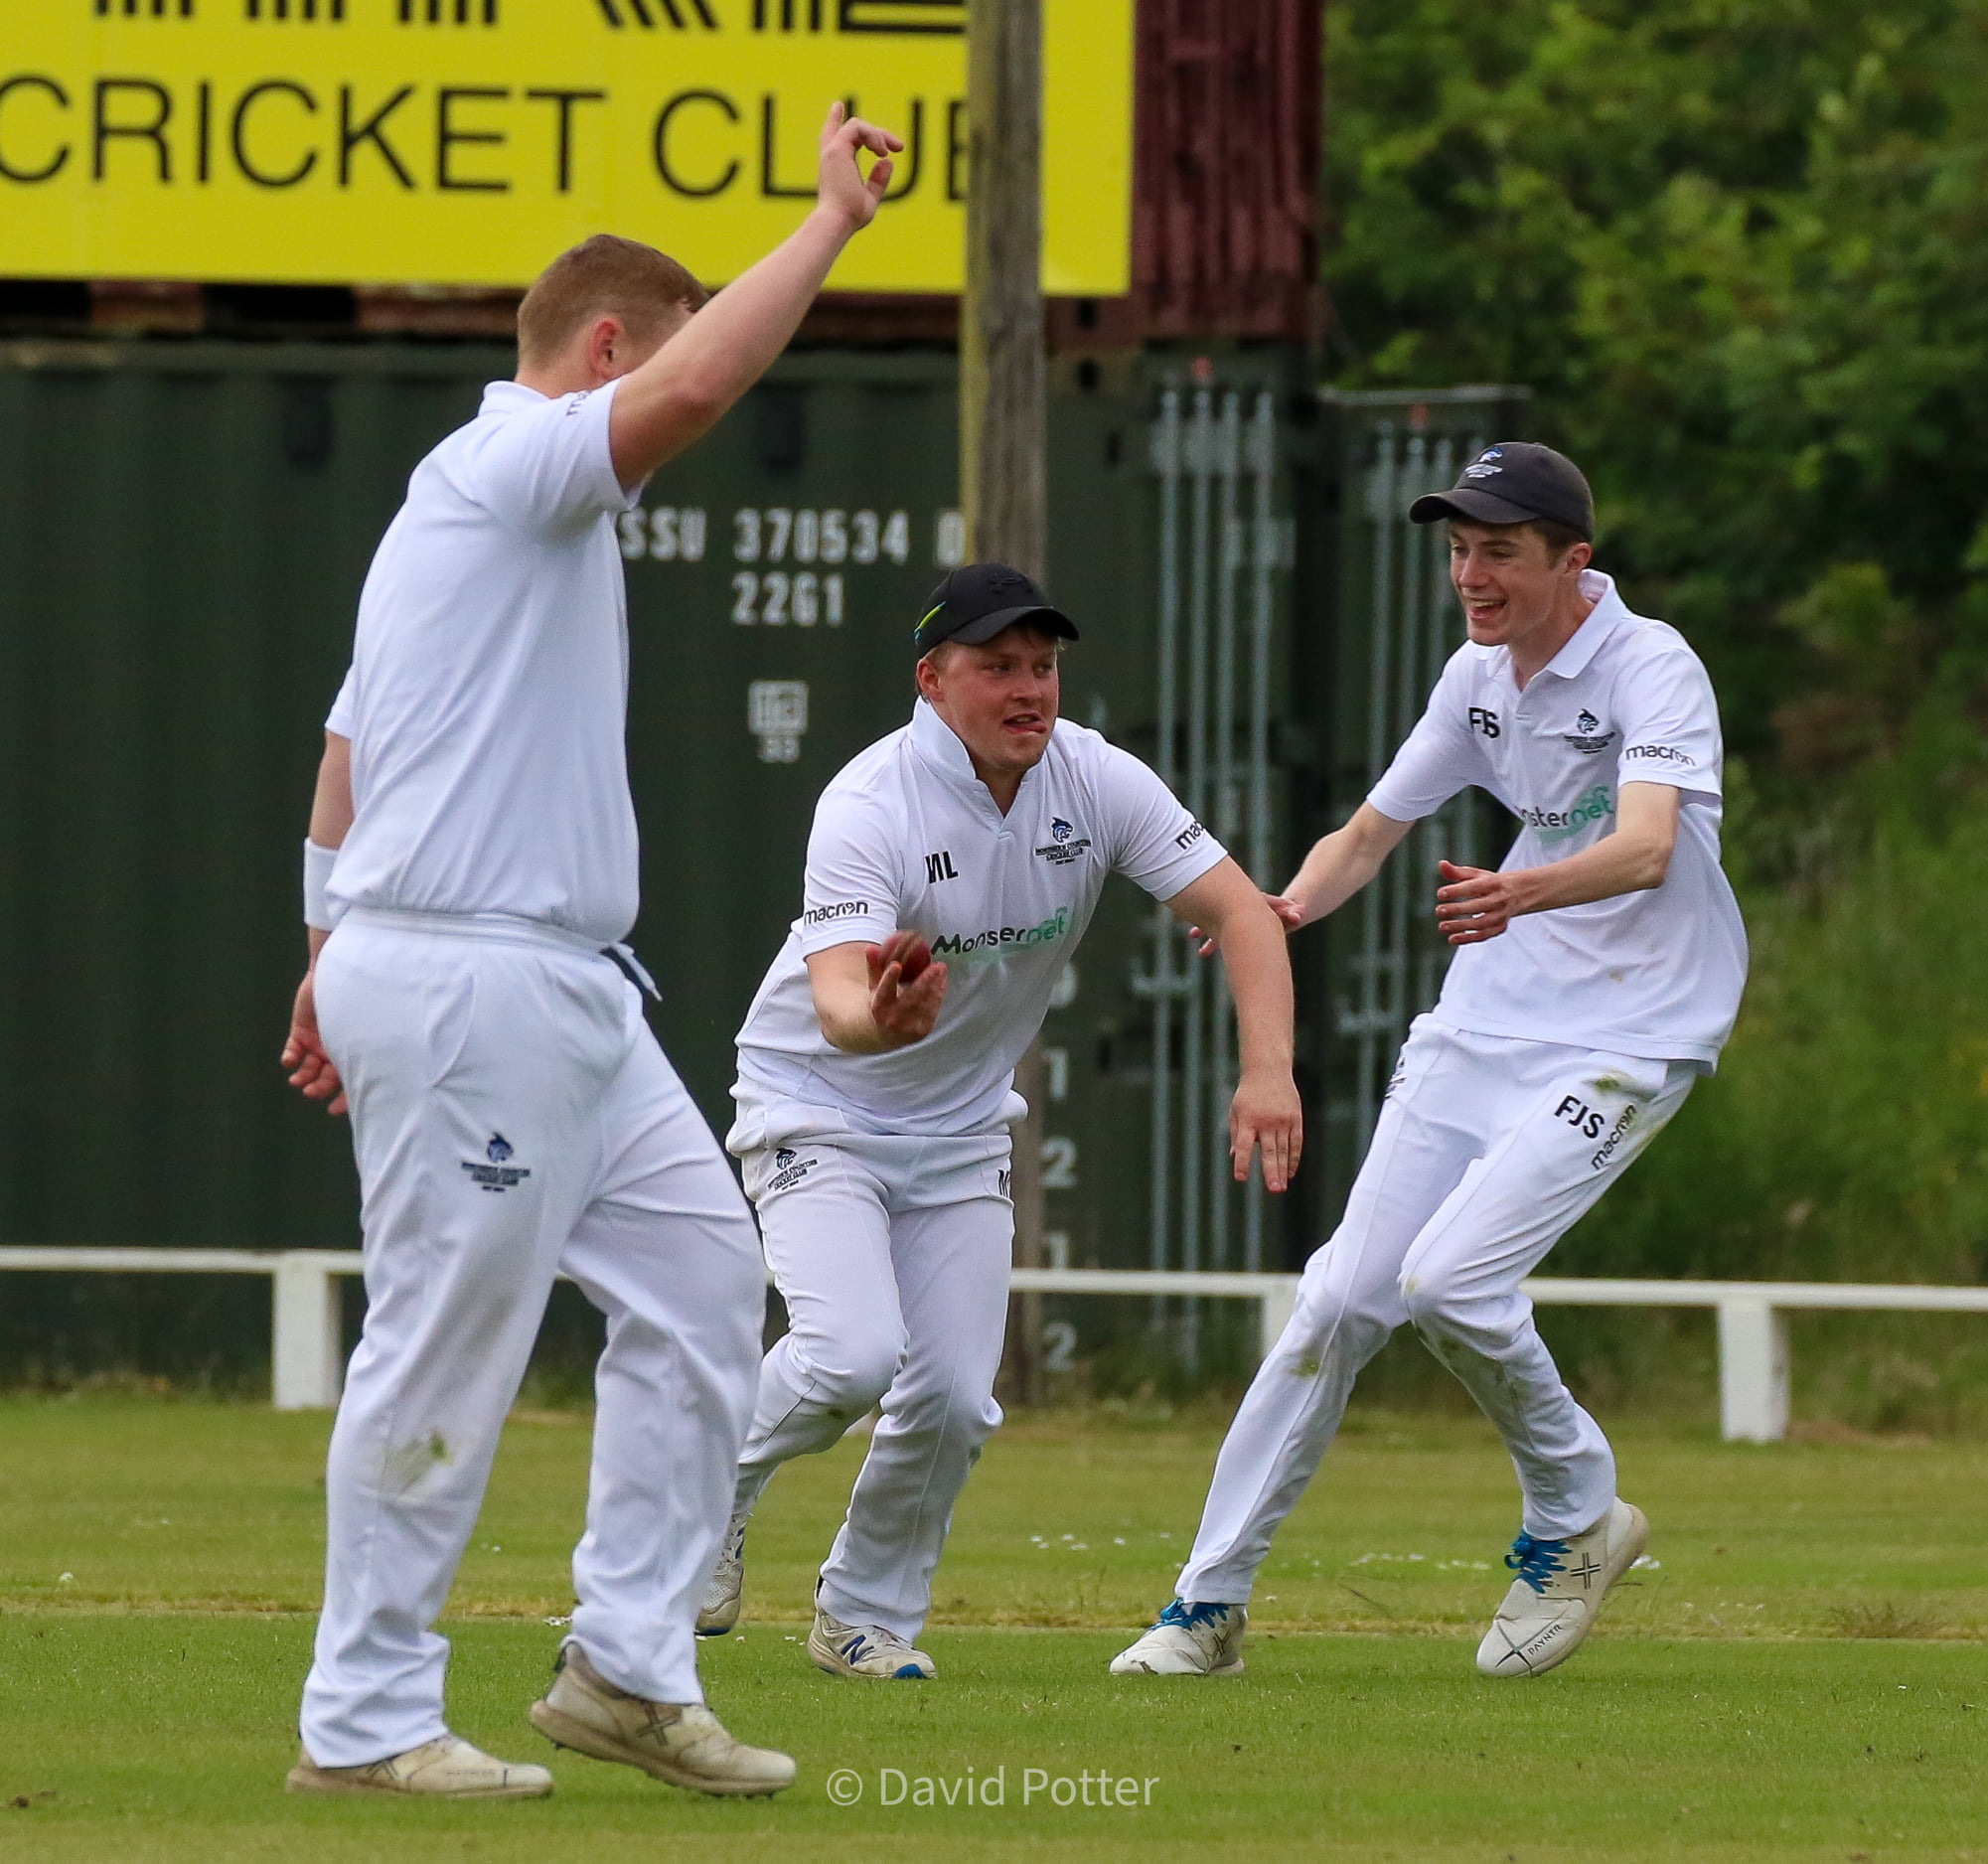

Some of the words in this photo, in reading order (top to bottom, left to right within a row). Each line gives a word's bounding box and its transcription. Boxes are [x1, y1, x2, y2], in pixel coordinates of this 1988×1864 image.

[0, 75, 604, 193] CRICKET
[733, 508, 909, 564] 370534
[1554, 1094, 1606, 1139] FJS
[1527, 1624, 1564, 1656] PAYNTR
